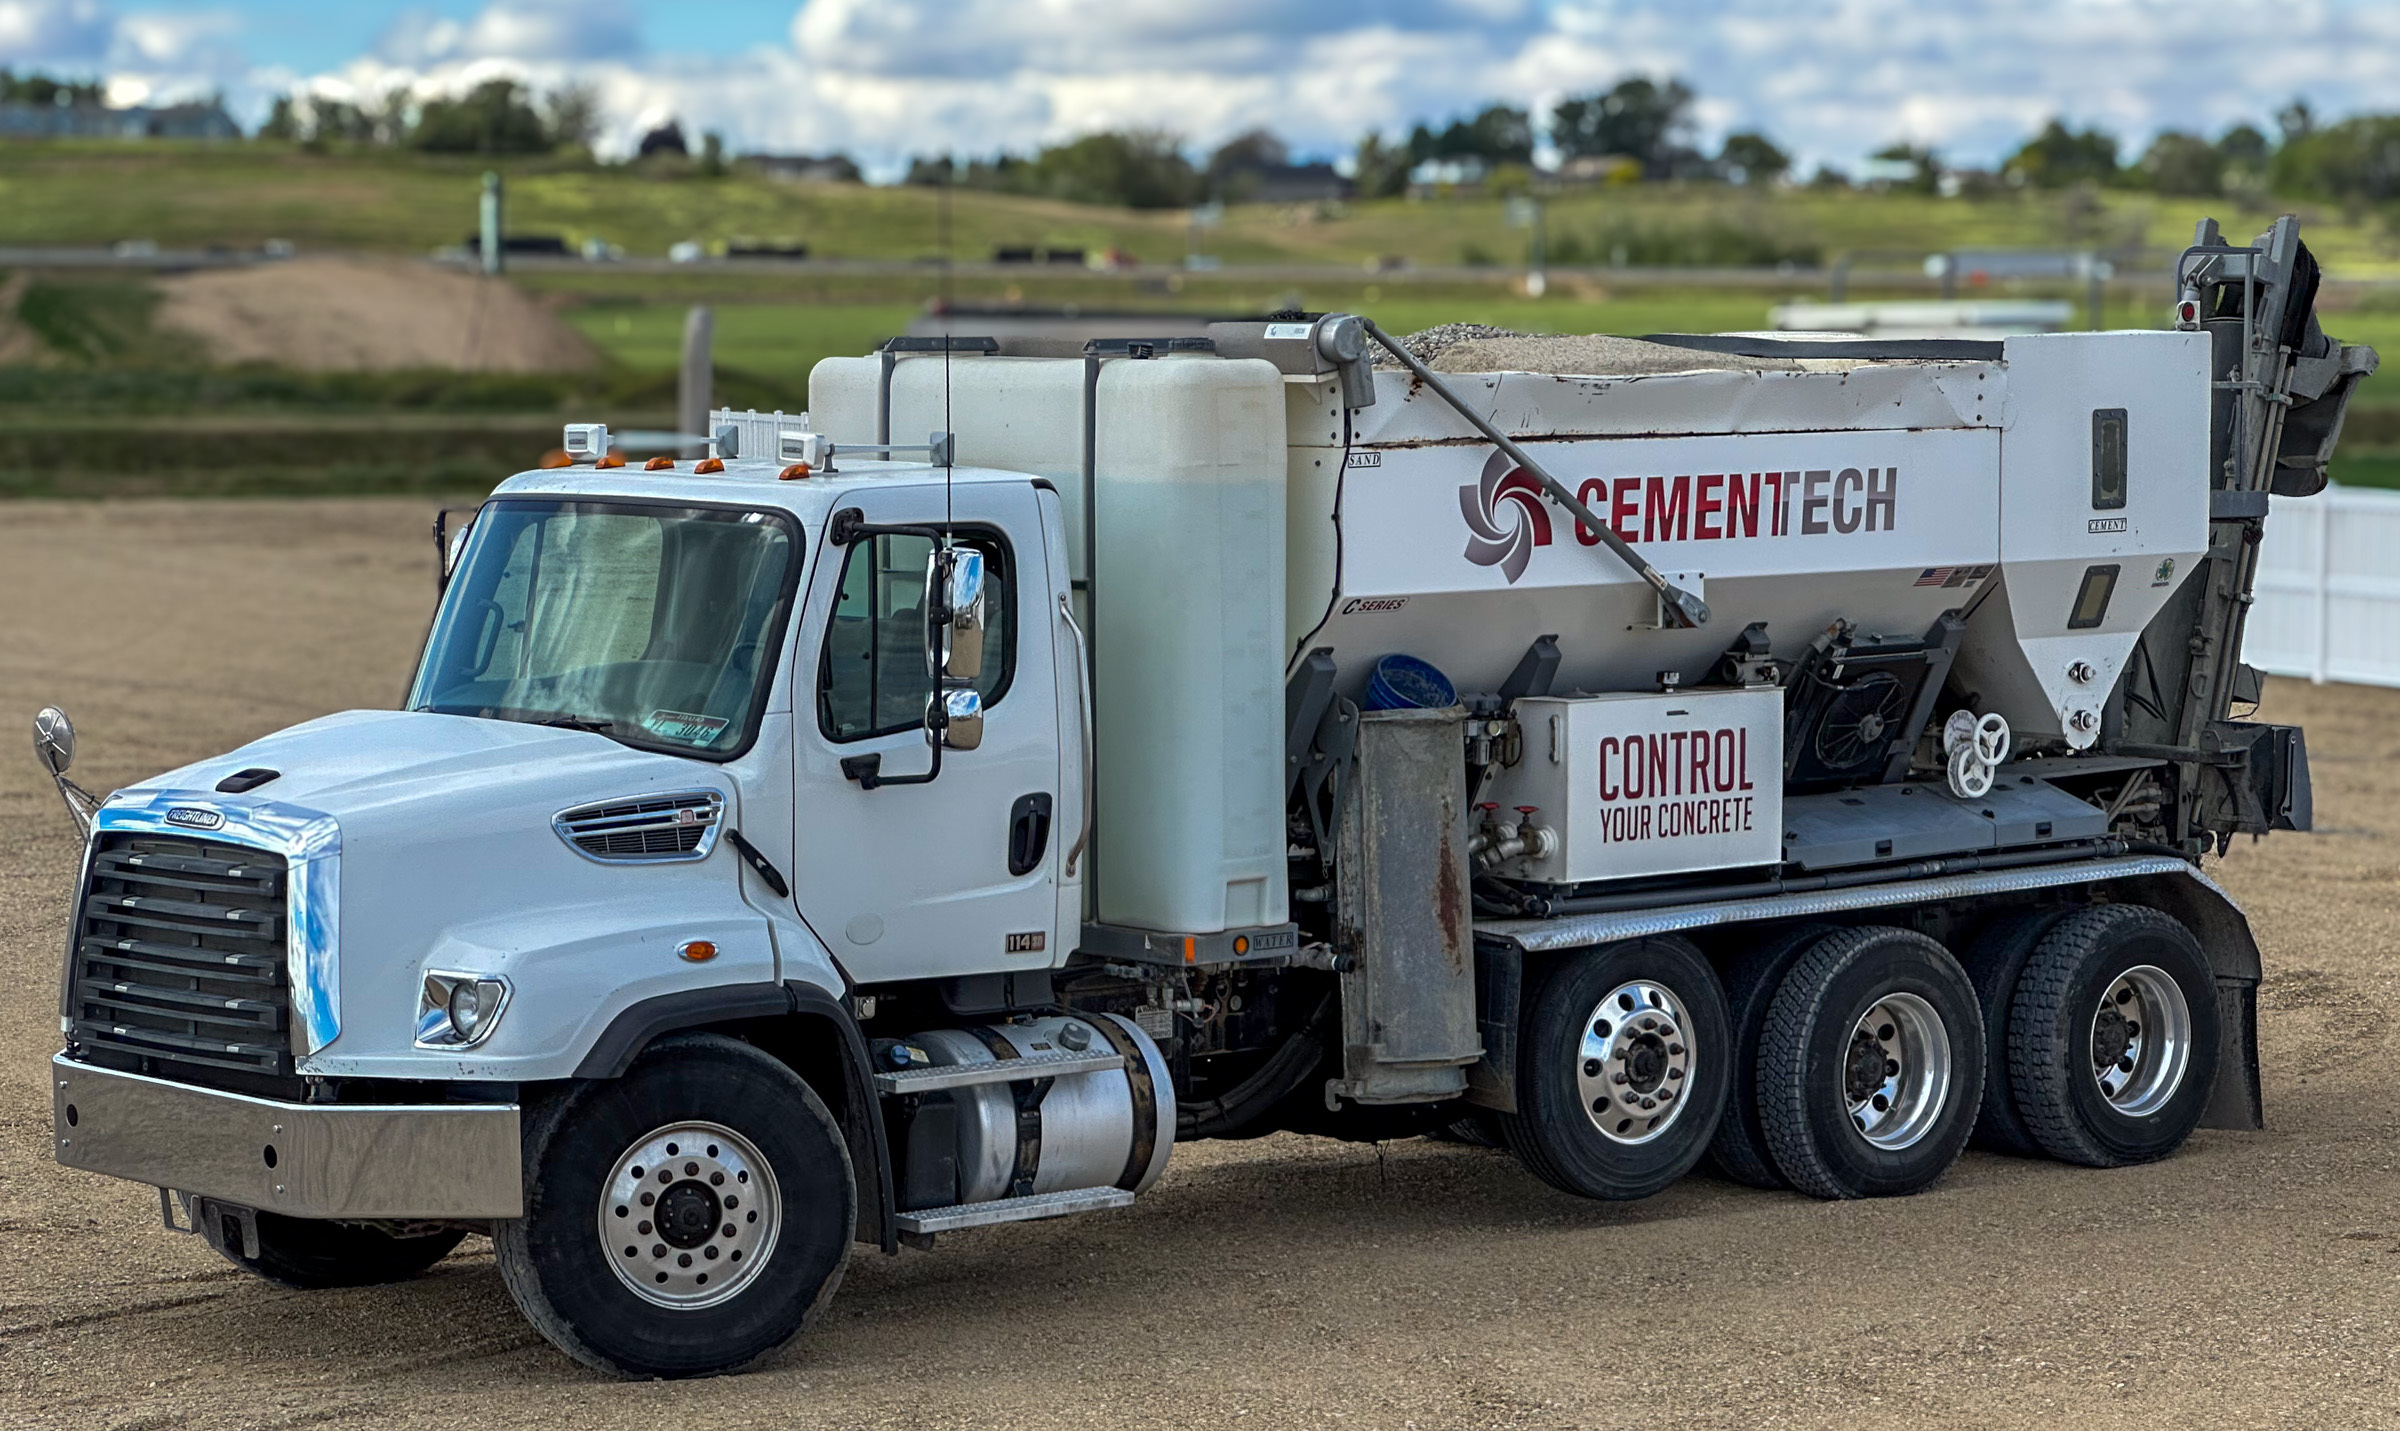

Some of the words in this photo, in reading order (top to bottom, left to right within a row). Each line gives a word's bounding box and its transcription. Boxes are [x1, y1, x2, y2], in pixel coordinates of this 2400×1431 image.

[1349, 454, 1380, 466] SAND
[2090, 520, 2125, 531] CEMENT
[1342, 598, 1361, 614] C
[1359, 599, 1405, 611] SERIES
[675, 722, 714, 738] 3046
[1600, 727, 1753, 801] CONTROL
[167, 809, 219, 825] FREIGHTLINER
[1600, 805, 1651, 843] YOUR
[1658, 797, 1752, 838] CONCRETE
[1255, 934, 1292, 948] WATER
